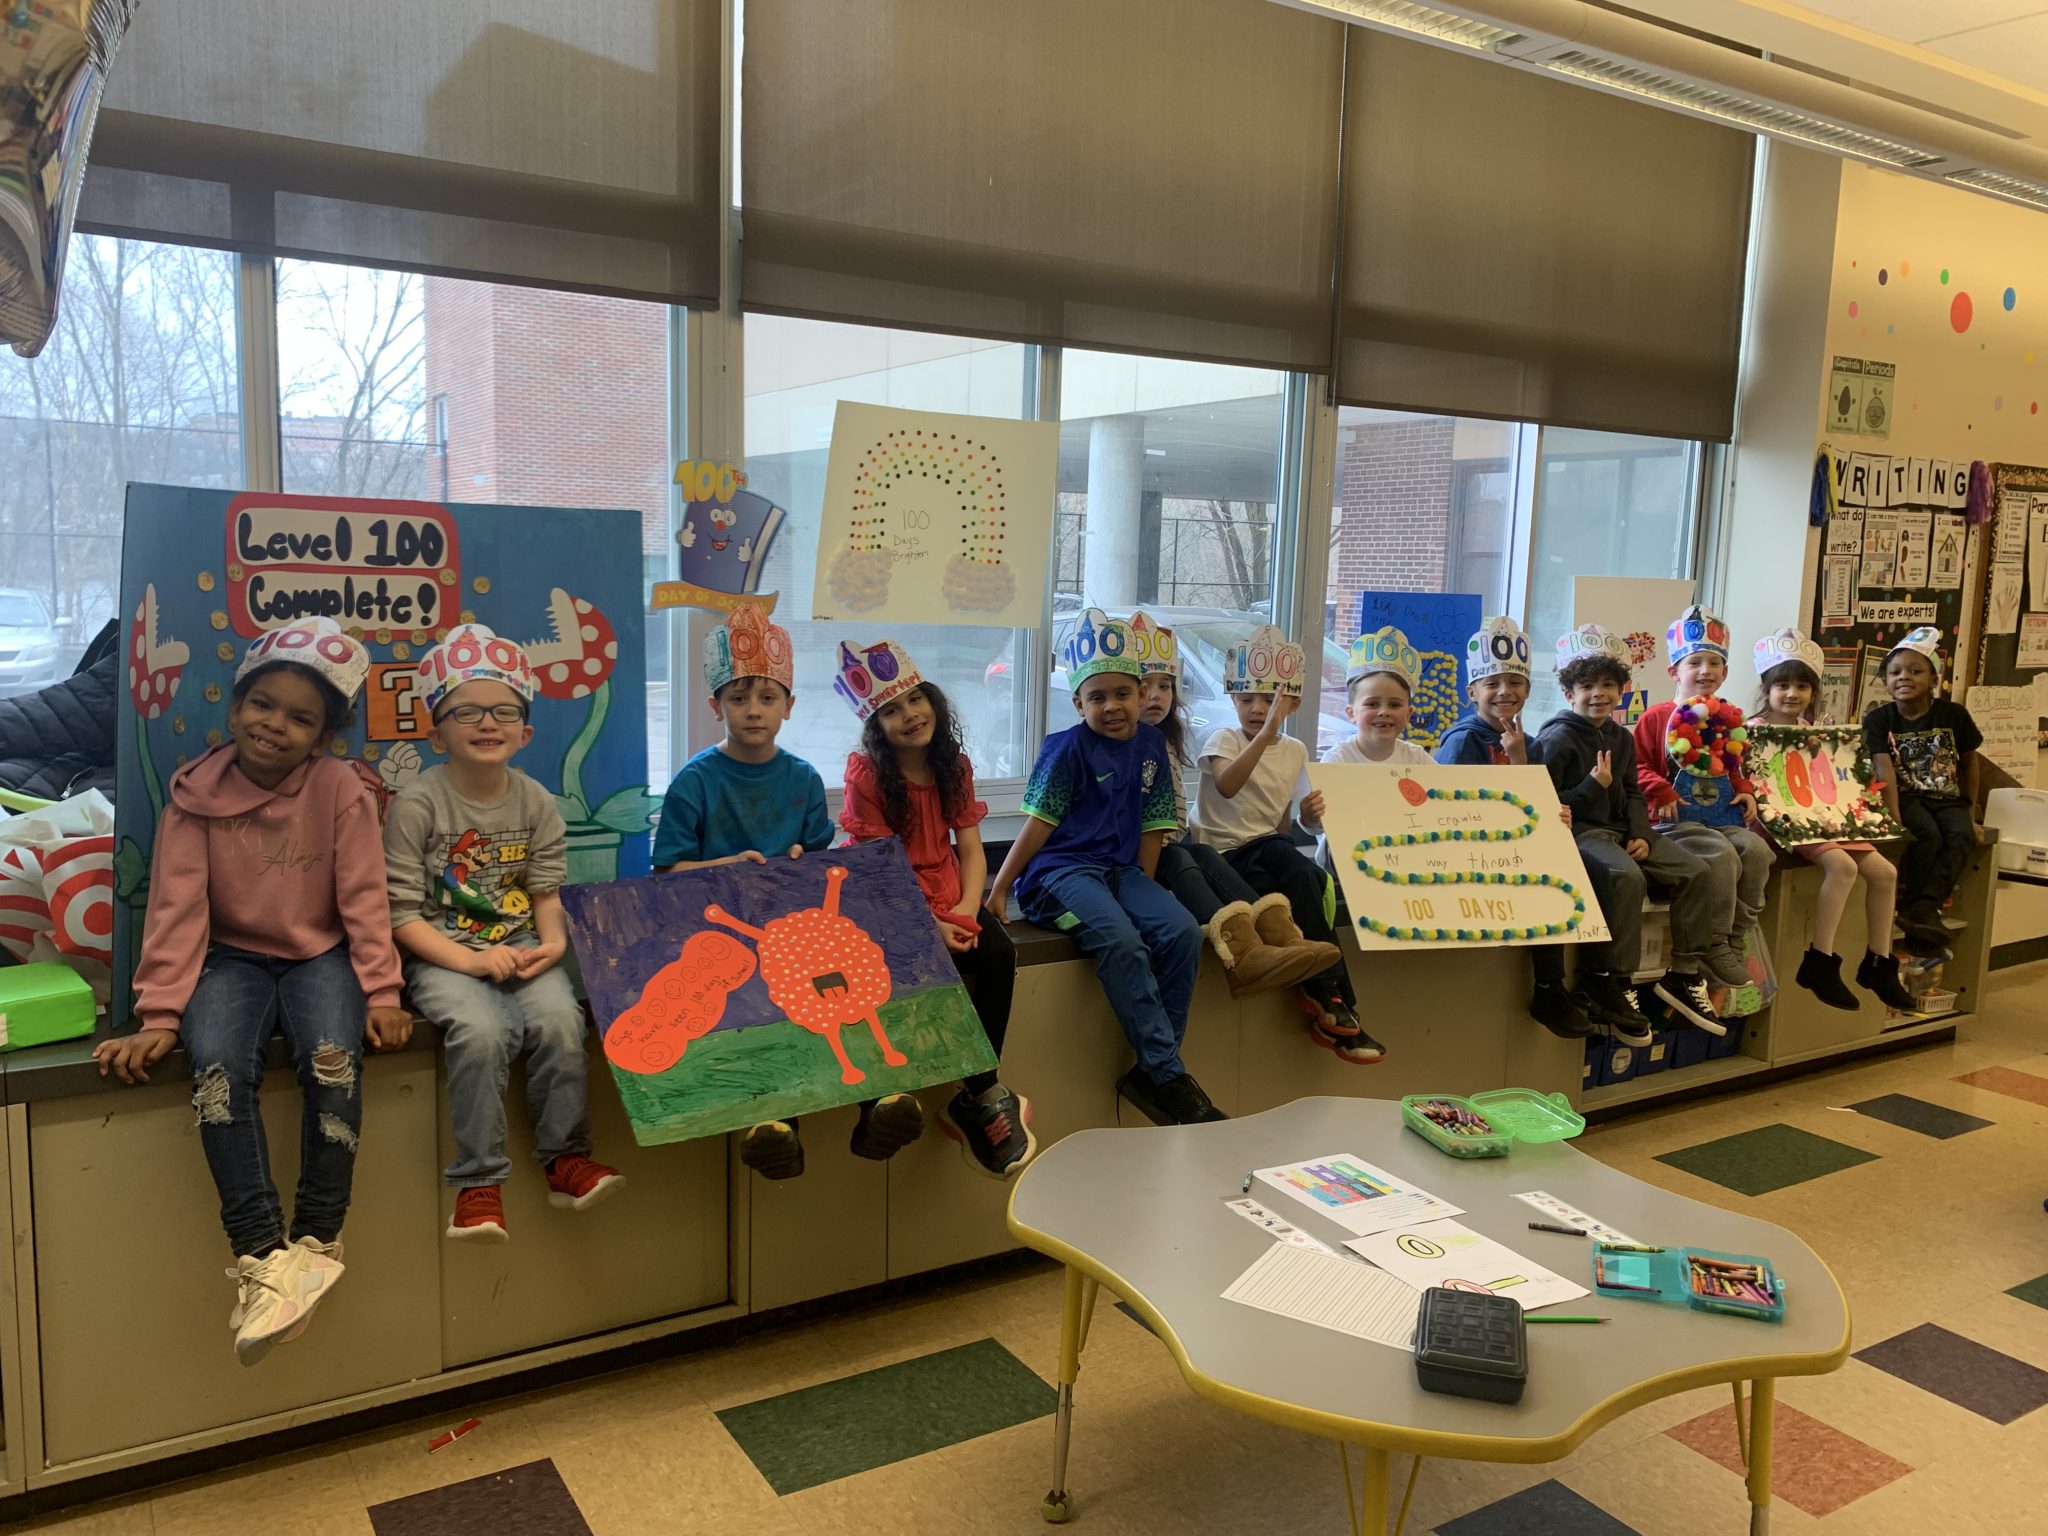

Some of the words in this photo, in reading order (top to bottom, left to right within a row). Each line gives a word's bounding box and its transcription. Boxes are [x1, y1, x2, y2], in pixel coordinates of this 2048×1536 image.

[1834, 456, 1967, 497] WRITING
[902, 509, 931, 531] 100
[1852, 509, 1863, 521] do
[238, 511, 353, 562] Level
[363, 519, 445, 568] 100
[893, 534, 921, 550] Days
[1830, 541, 1858, 553] write?
[248, 575, 436, 627] Complete!
[658, 590, 689, 601] DAY
[1860, 605, 1875, 620] We
[1877, 607, 1895, 620] are
[1897, 604, 1935, 620] experts!
[257, 630, 354, 664] 100
[716, 628, 787, 667] 100
[1069, 625, 1125, 672] 100
[1135, 629, 1173, 661] 00
[1480, 634, 1529, 664] 100
[1569, 632, 1625, 656] 100
[1675, 620, 1725, 648] 100
[1766, 637, 1818, 661] 100
[433, 640, 518, 682] 100
[1237, 645, 1298, 680] 100
[1365, 637, 1418, 674] 100
[1471, 663, 1498, 679] Days
[835, 650, 899, 707] 100
[1767, 749, 1838, 808] 100
[1403, 812, 1424, 829] I
[1437, 811, 1483, 829] crawled
[1426, 855, 1447, 871] way
[1403, 898, 1435, 922] 100
[1458, 897, 1516, 922] DAYS!
[445, 909, 508, 942] SUPER
[610, 1029, 633, 1047] Eye
[669, 1008, 691, 1029] seen
[705, 975, 721, 992] days
